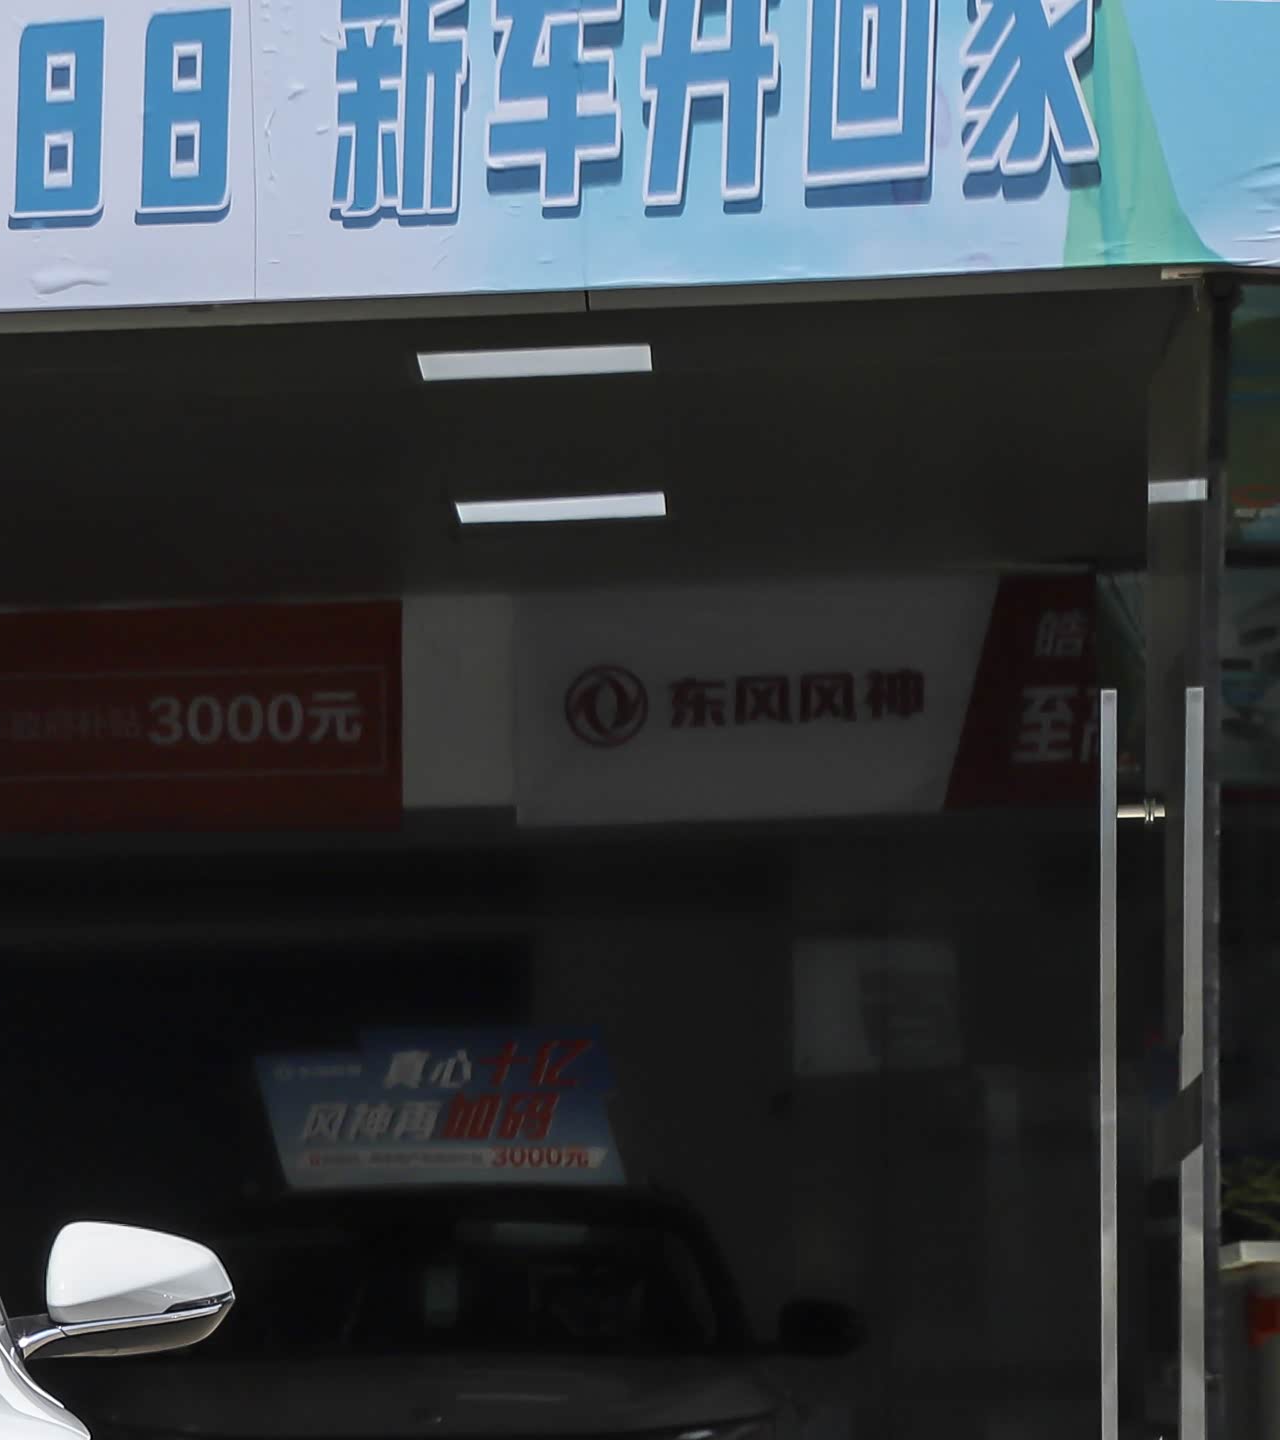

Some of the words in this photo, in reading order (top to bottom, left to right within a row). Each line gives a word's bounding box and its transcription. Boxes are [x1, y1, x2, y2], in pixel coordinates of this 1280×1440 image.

[146, 688, 364, 748] 3000元
[670, 667, 927, 730] 东风风神
